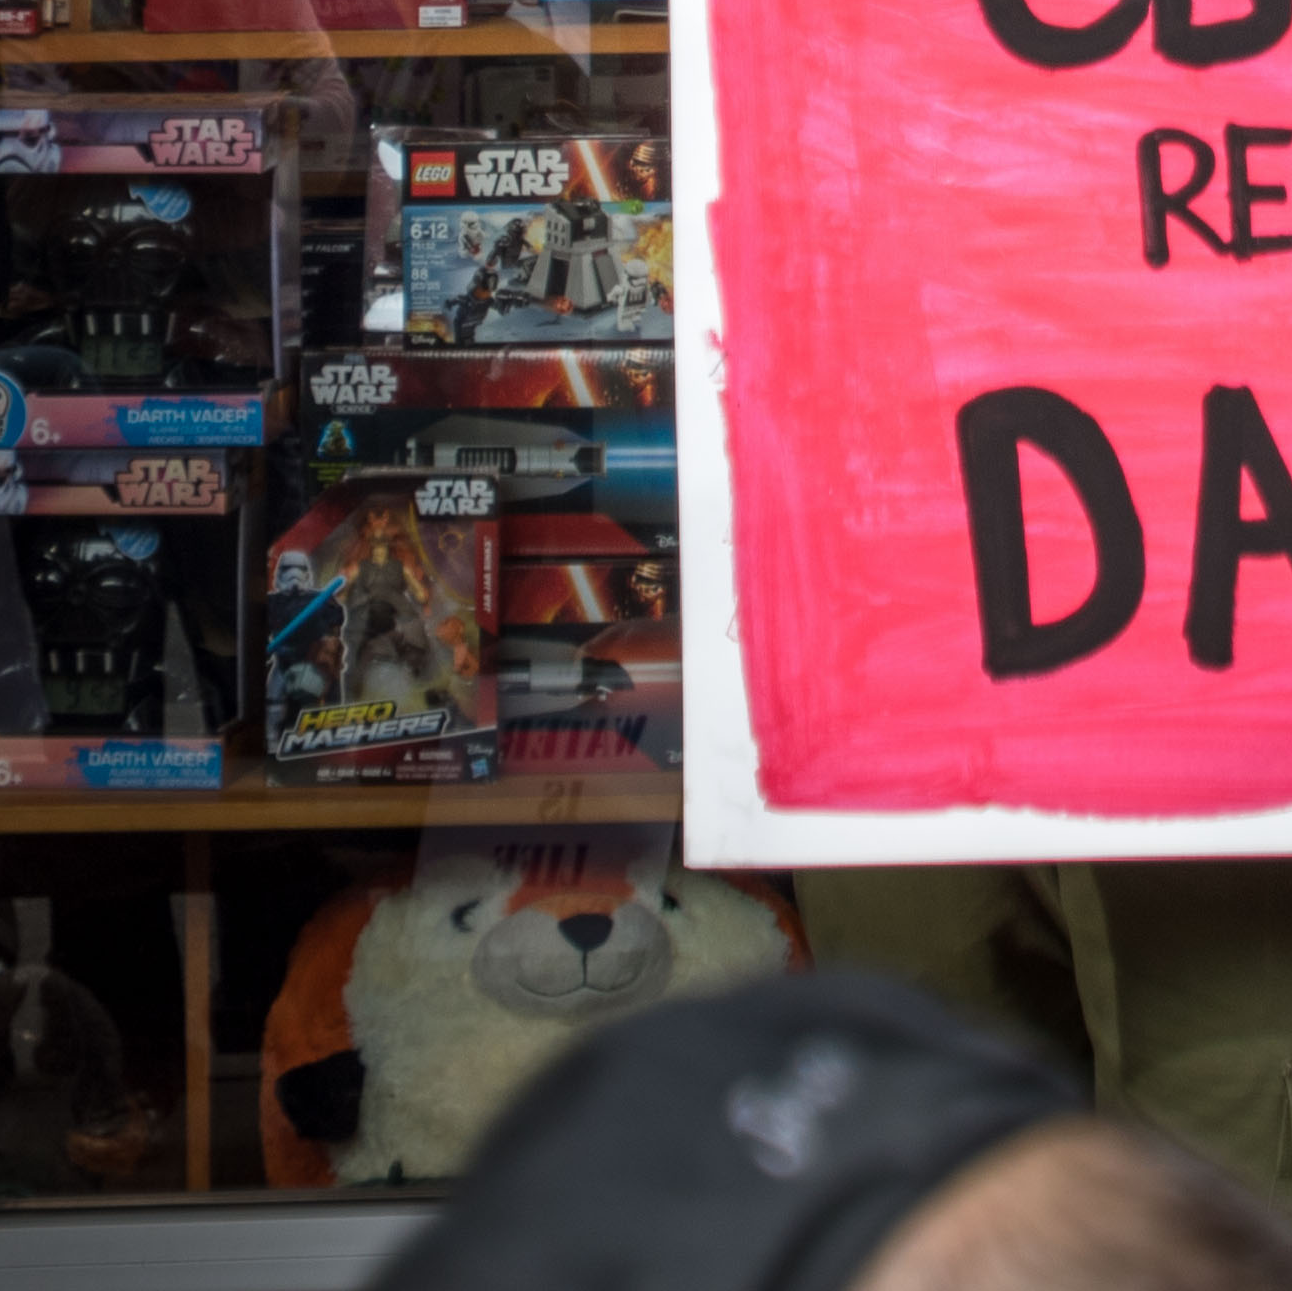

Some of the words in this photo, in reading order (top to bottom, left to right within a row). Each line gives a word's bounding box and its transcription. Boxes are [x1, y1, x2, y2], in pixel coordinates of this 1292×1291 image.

[152, 118, 255, 143] STAR
[152, 139, 255, 165] WARS
[414, 163, 453, 183] LEGO
[463, 149, 570, 175] STAR
[463, 172, 570, 198] WARS
[409, 222, 449, 241] 6-12
[410, 267, 429, 281] 88
[309, 363, 398, 387] STAR
[310, 384, 398, 407] WARS
[126, 409, 187, 424] DARTH
[189, 409, 248, 424] VADER
[30, 419, 61, 445] 6+
[115, 458, 220, 484] STAR
[115, 481, 220, 507] WARS
[414, 478, 496, 499] STAR
[414, 496, 496, 517] WARS
[298, 701, 397, 733] HERO
[282, 713, 447, 755] MASHERS
[88, 751, 147, 767] DARTH
[149, 751, 208, 767] VADER
